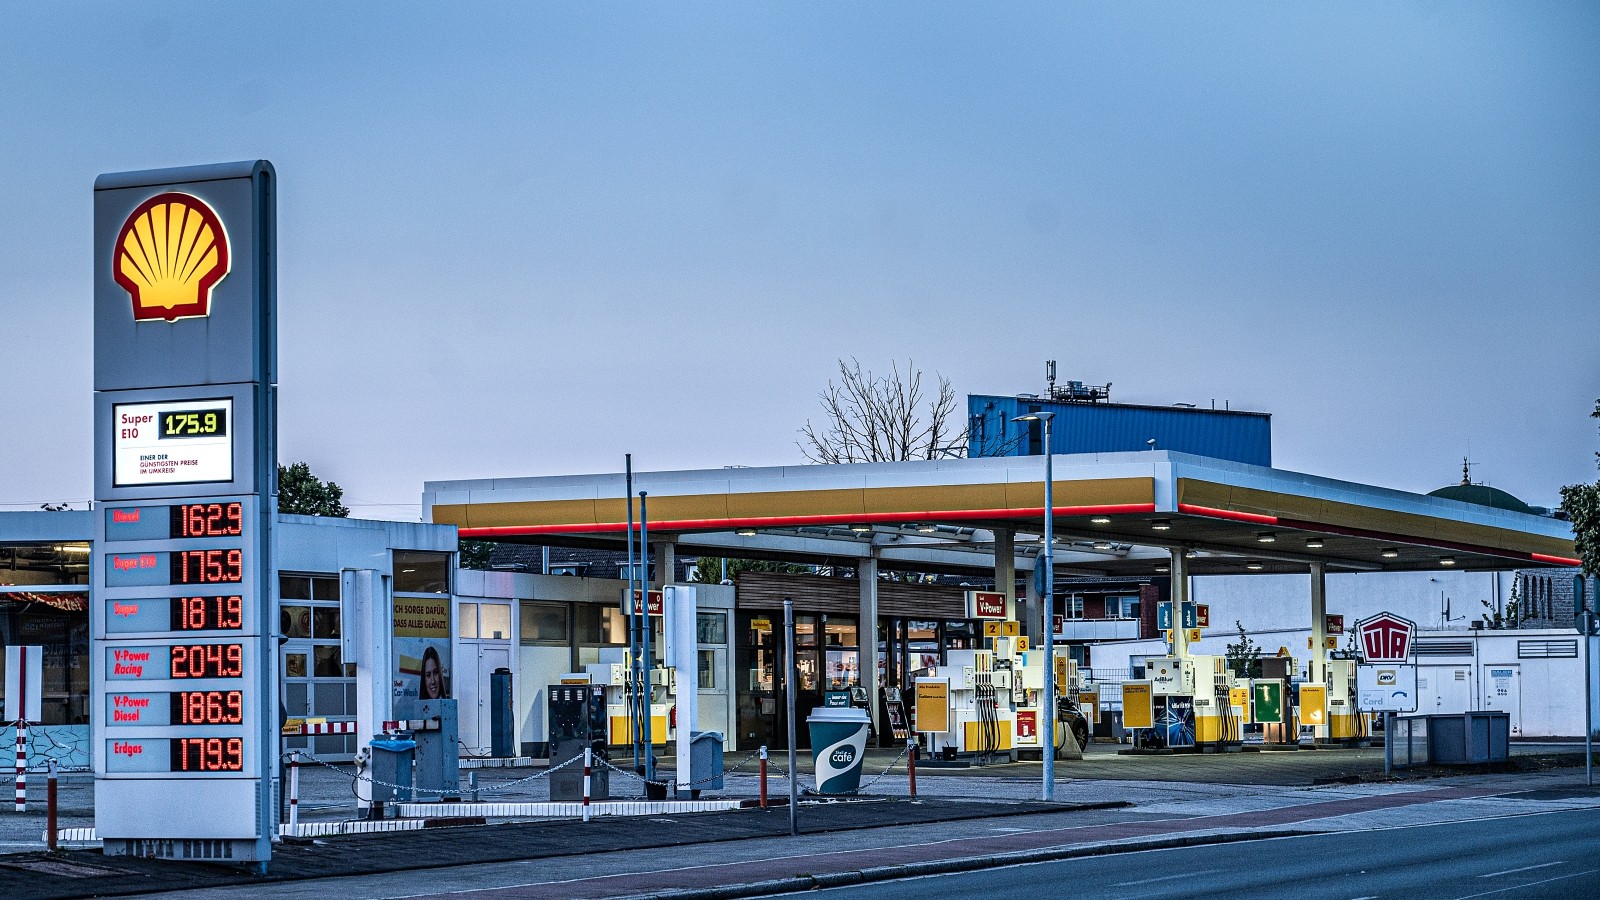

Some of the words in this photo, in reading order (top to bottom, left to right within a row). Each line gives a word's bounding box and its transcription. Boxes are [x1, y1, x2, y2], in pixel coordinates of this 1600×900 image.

[121, 413, 153, 426] Super
[166, 413, 217, 435] 175.9
[121, 428, 139, 439] E10
[113, 508, 140, 523] Diesel
[181, 503, 242, 536] 162.9
[113, 555, 138, 571] Super
[140, 555, 156, 568] E10
[181, 550, 242, 583] 175.9
[114, 602, 139, 618] Super
[181, 596, 242, 629] 181.9
[404, 605, 424, 614] SORGE
[425, 604, 447, 616] DAFÜR,
[980, 602, 1002, 614] V-Power
[394, 619, 407, 628] DASS
[408, 619, 424, 628] ALLES
[989, 625, 996, 633] 2
[1009, 625, 1014, 633] 1
[1193, 632, 1198, 640] 5
[1363, 619, 1409, 658] UTA
[1020, 640, 1026, 649] 3
[114, 650, 150, 661] V-Power
[172, 644, 242, 677] 204.9
[114, 663, 143, 678] Racing
[114, 696, 150, 708] V-Power
[181, 691, 242, 724] 186.9
[114, 709, 140, 722] Diesel
[114, 742, 143, 757] Erdgas
[181, 738, 242, 770] 179.9
[832, 752, 853, 762] café
